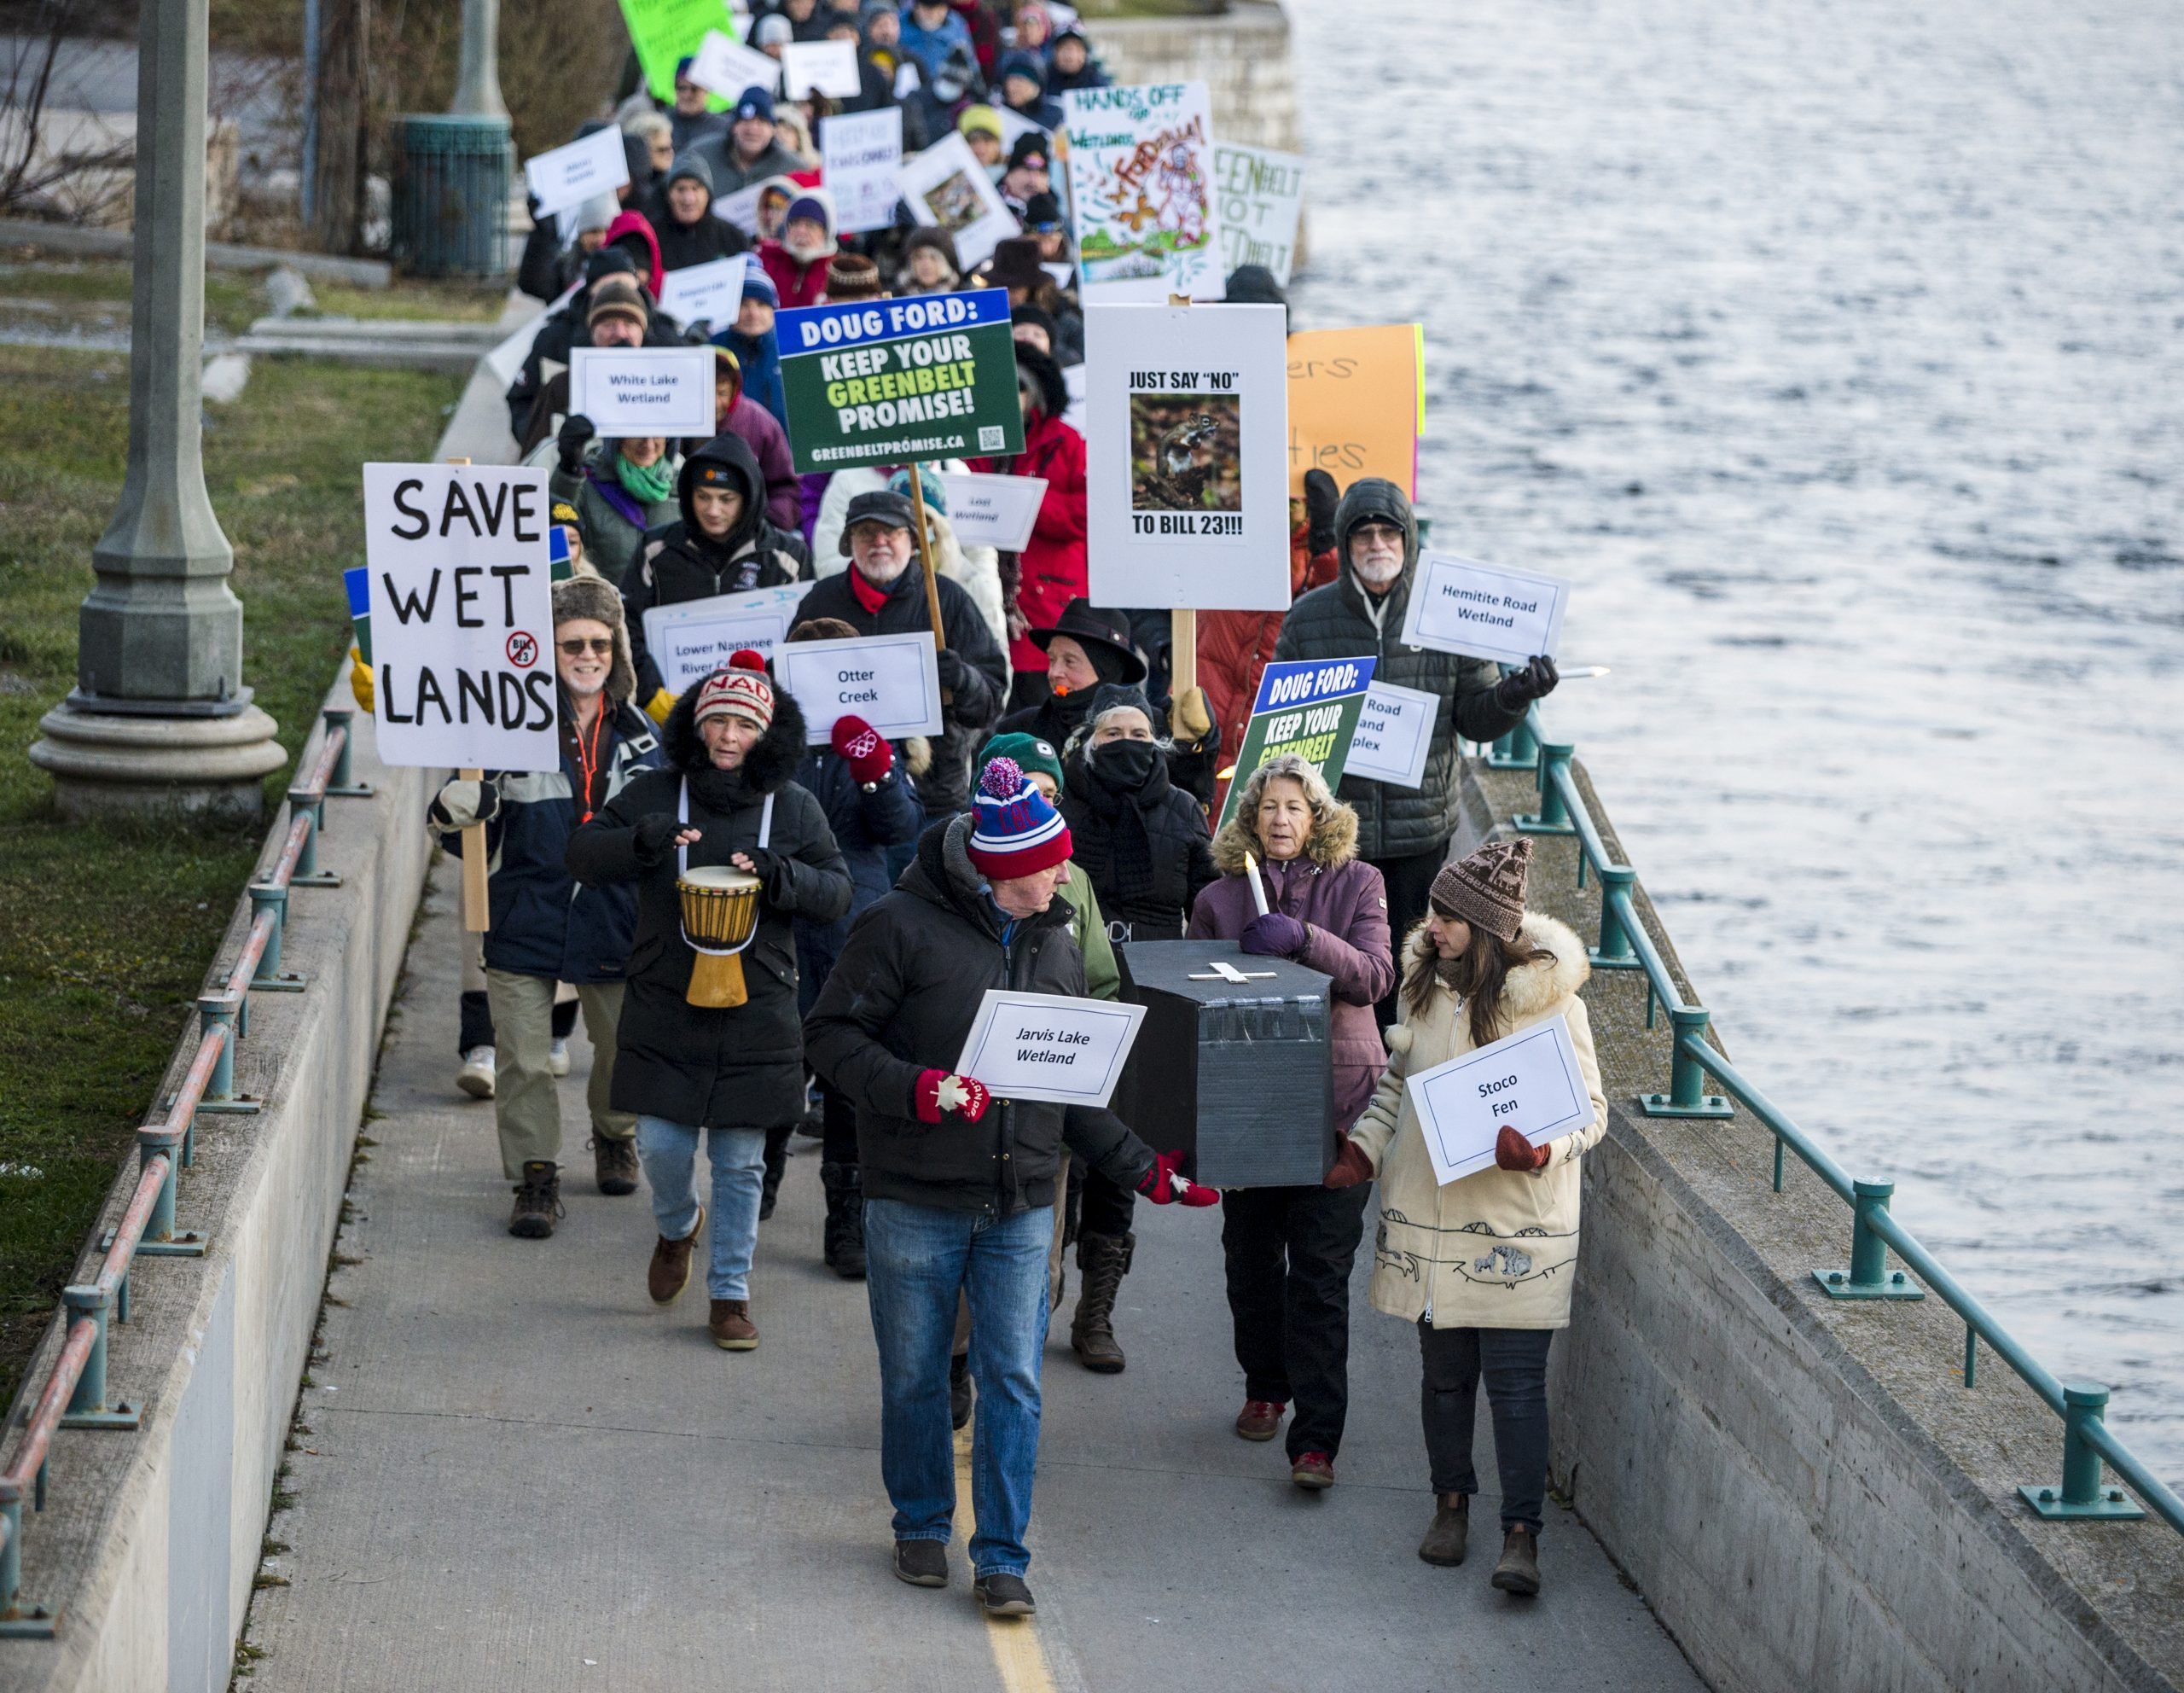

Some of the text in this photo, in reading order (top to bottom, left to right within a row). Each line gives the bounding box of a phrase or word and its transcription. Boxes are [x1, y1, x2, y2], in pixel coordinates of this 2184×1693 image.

[1148, 84, 1186, 107] OFF
[1219, 195, 1275, 227] OT
[800, 298, 979, 347] DOUG FORD:
[820, 335, 973, 381] KEEP YOUR
[1287, 358, 1358, 379] ers
[609, 375, 679, 385] White Lake
[827, 360, 975, 408] GREENBELT
[1130, 371, 1166, 389] JUST
[1170, 371, 1199, 389] SAY
[617, 393, 671, 404] Wetland
[838, 387, 975, 434] PROMISE!
[811, 435, 965, 462] GREENBELTPROMISE.CA
[1288, 426, 1367, 470] ties
[391, 479, 540, 542] SAVE
[956, 511, 999, 523] Wetland
[1132, 515, 1243, 535] TO BILL 23!!!
[383, 566, 530, 627] WET
[1443, 584, 1538, 613] Hemitite Road
[1458, 607, 1513, 628] Wetland
[677, 637, 773, 656] Lower Napanee
[682, 662, 713, 674] River
[838, 670, 875, 683] Otter
[706, 675, 775, 709] NAD
[1269, 663, 1359, 706] DOUG FORD:
[383, 664, 555, 731] LANDS
[839, 689, 878, 703] Creek
[1368, 699, 1402, 716] Road
[1263, 704, 1343, 745] KEEP YOUR
[1359, 719, 1385, 732] and
[1352, 736, 1380, 751] plex
[998, 800, 1038, 834] CBC
[1016, 1027, 1090, 1045] Jarvis Lake
[1016, 1049, 1076, 1065] Wetland
[1478, 1074, 1518, 1098] Stoco
[1492, 1099, 1519, 1117] Fen
